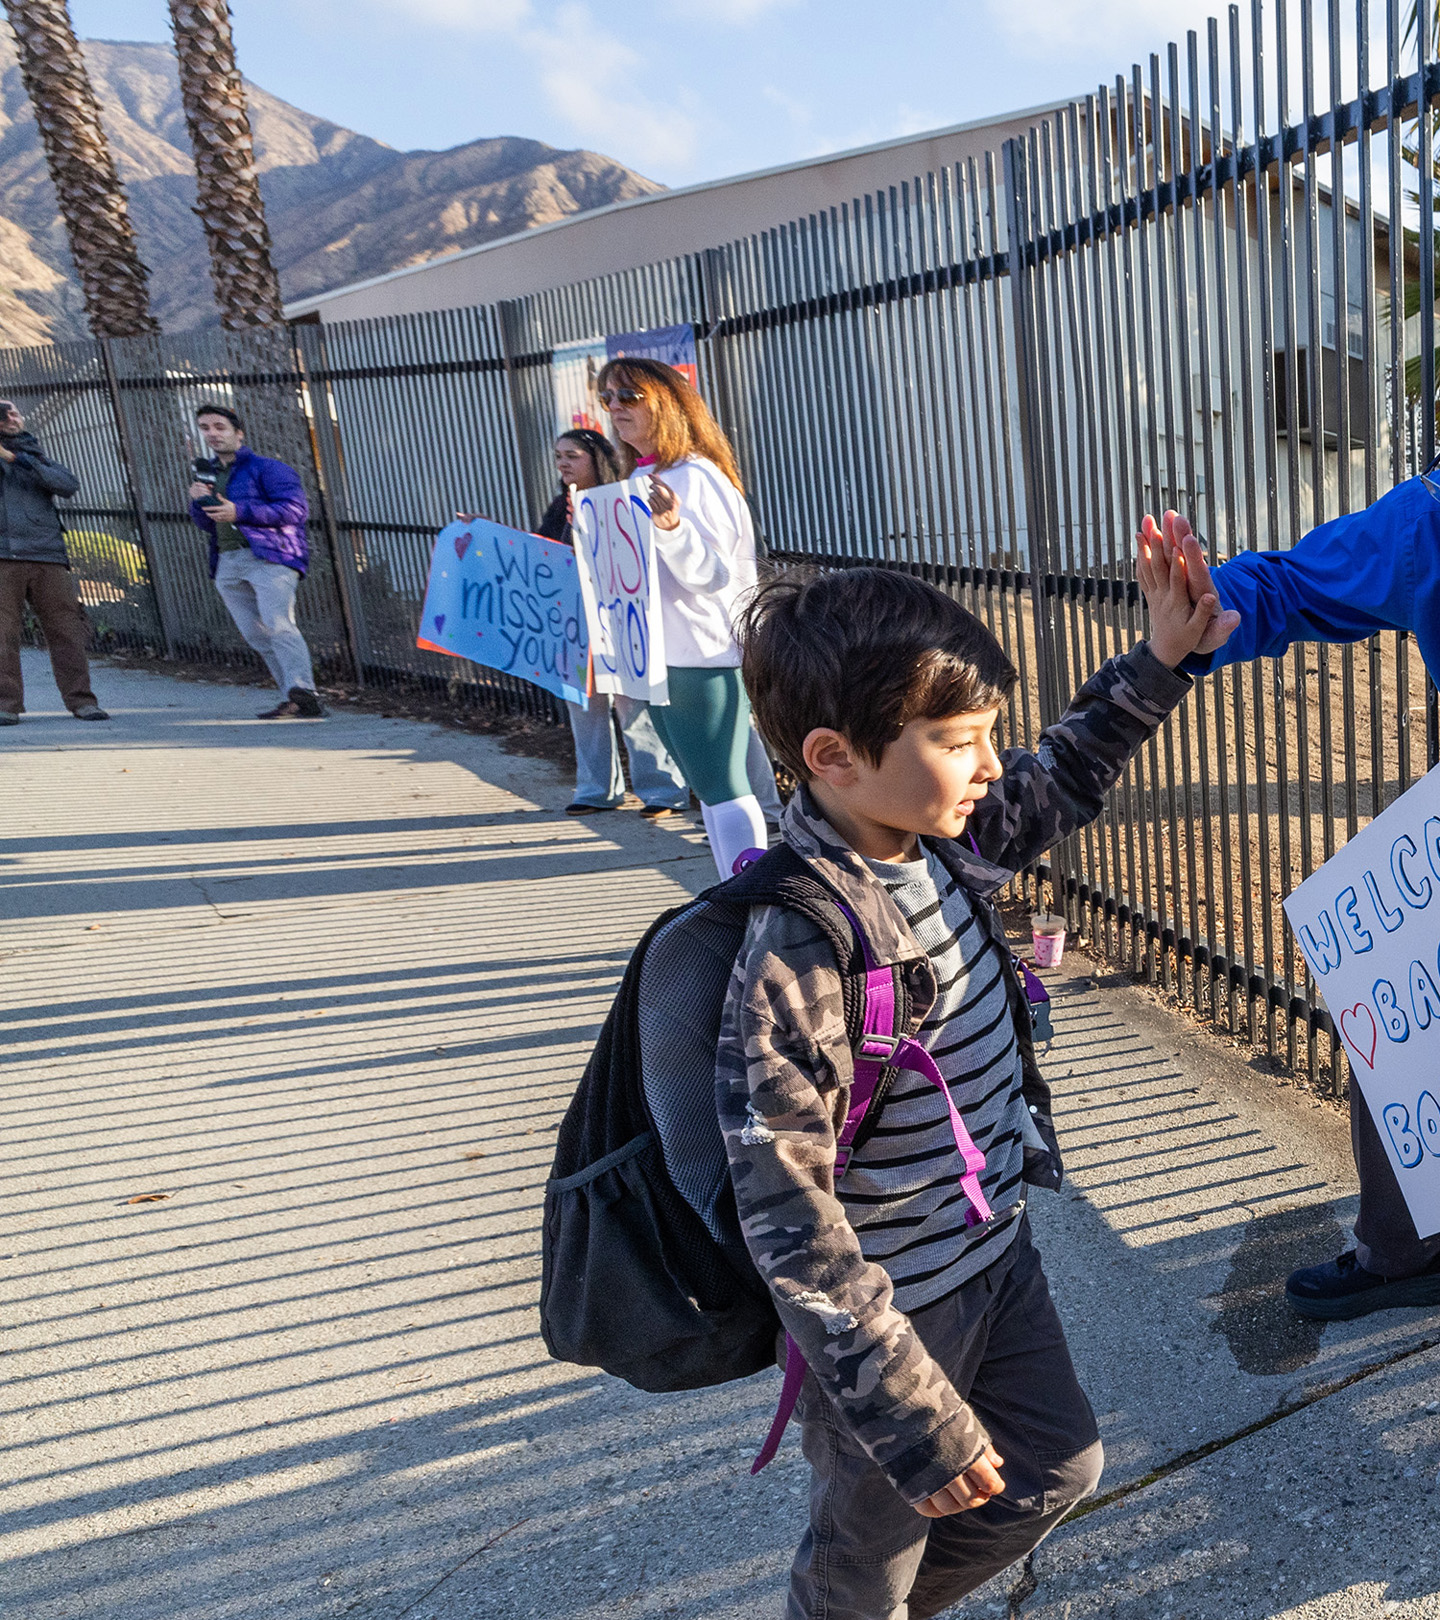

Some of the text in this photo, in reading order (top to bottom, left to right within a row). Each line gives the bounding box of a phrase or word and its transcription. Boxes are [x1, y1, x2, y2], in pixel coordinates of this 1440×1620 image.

[494, 537, 562, 598] We
[463, 576, 587, 649] missed
[499, 628, 569, 680] you!
